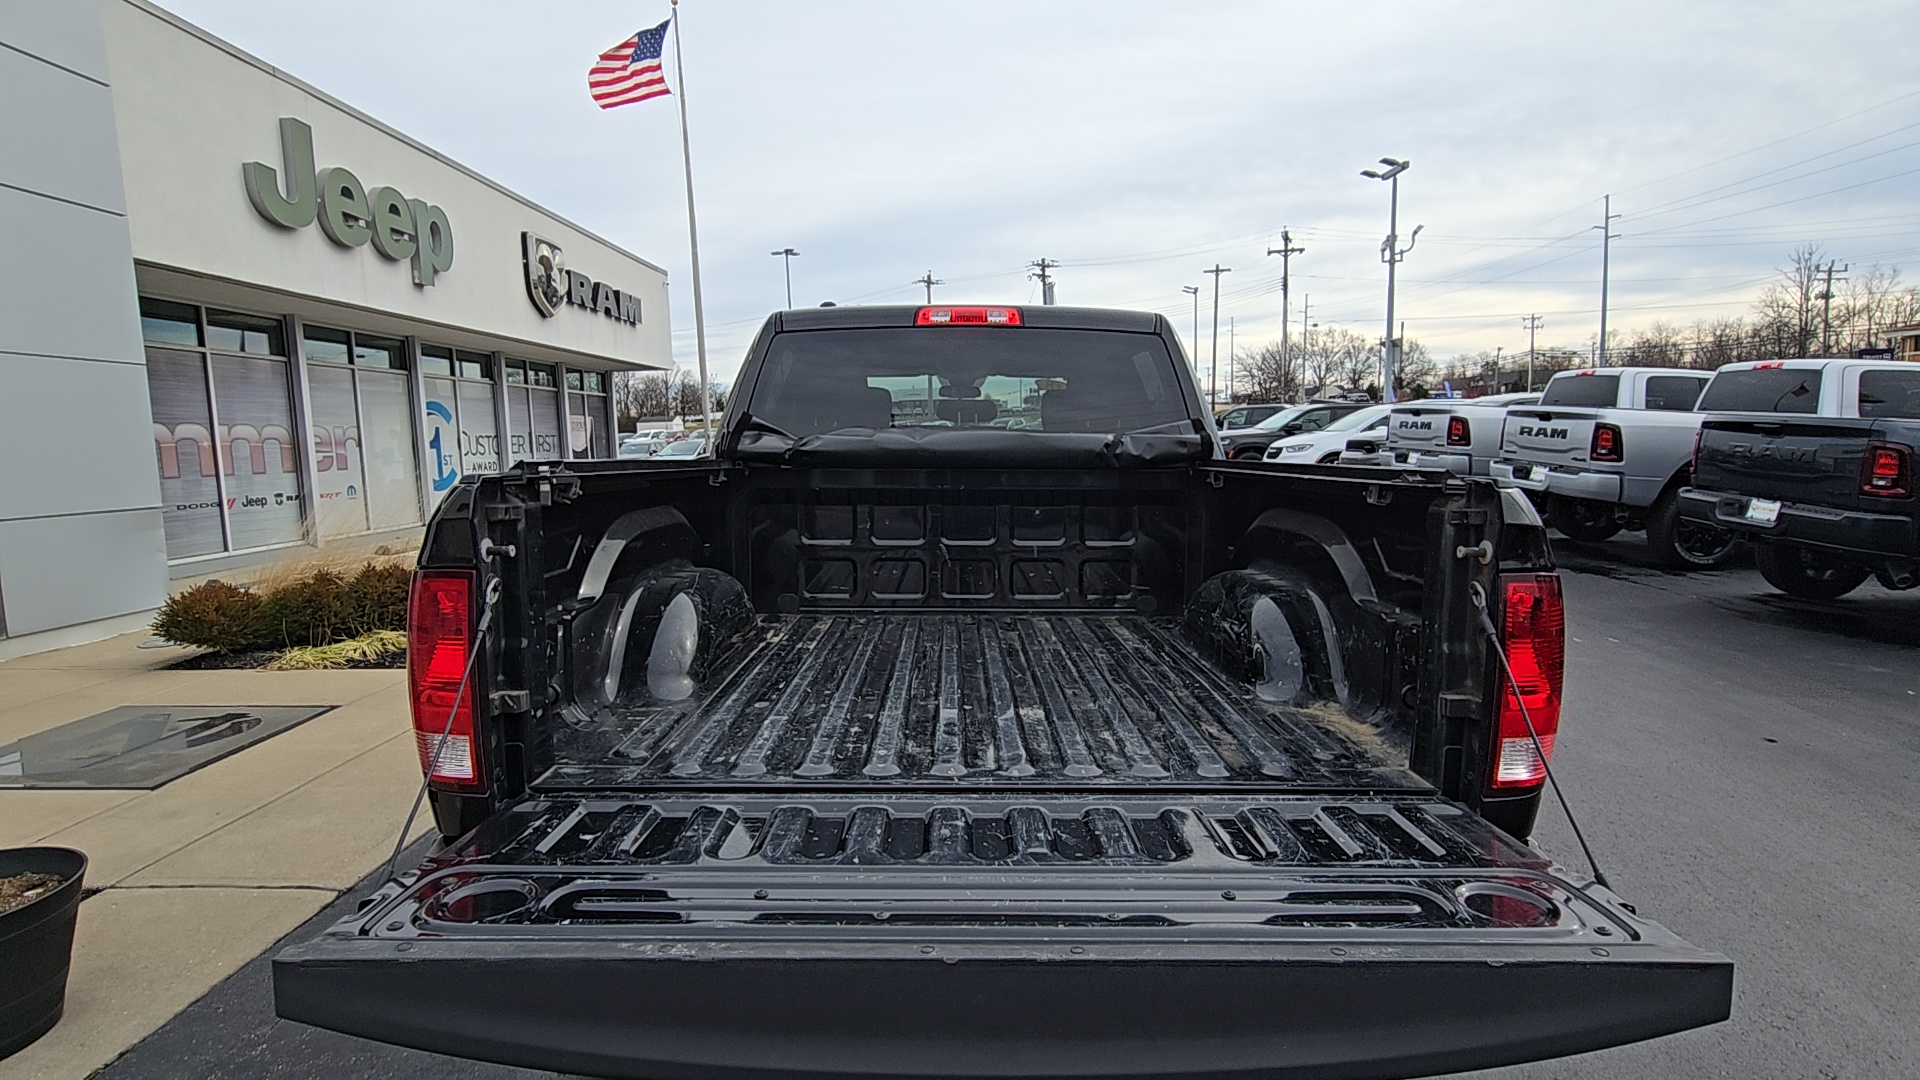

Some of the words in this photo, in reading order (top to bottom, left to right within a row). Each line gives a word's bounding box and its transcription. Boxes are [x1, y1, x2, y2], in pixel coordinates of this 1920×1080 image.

[243, 117, 454, 287] Jeep
[567, 269, 643, 327] RAM
[1399, 421, 1432, 430] RAM
[1519, 426, 1568, 439] RAM
[1729, 442, 1818, 463] RAM
[241, 495, 267, 508] Jeep
